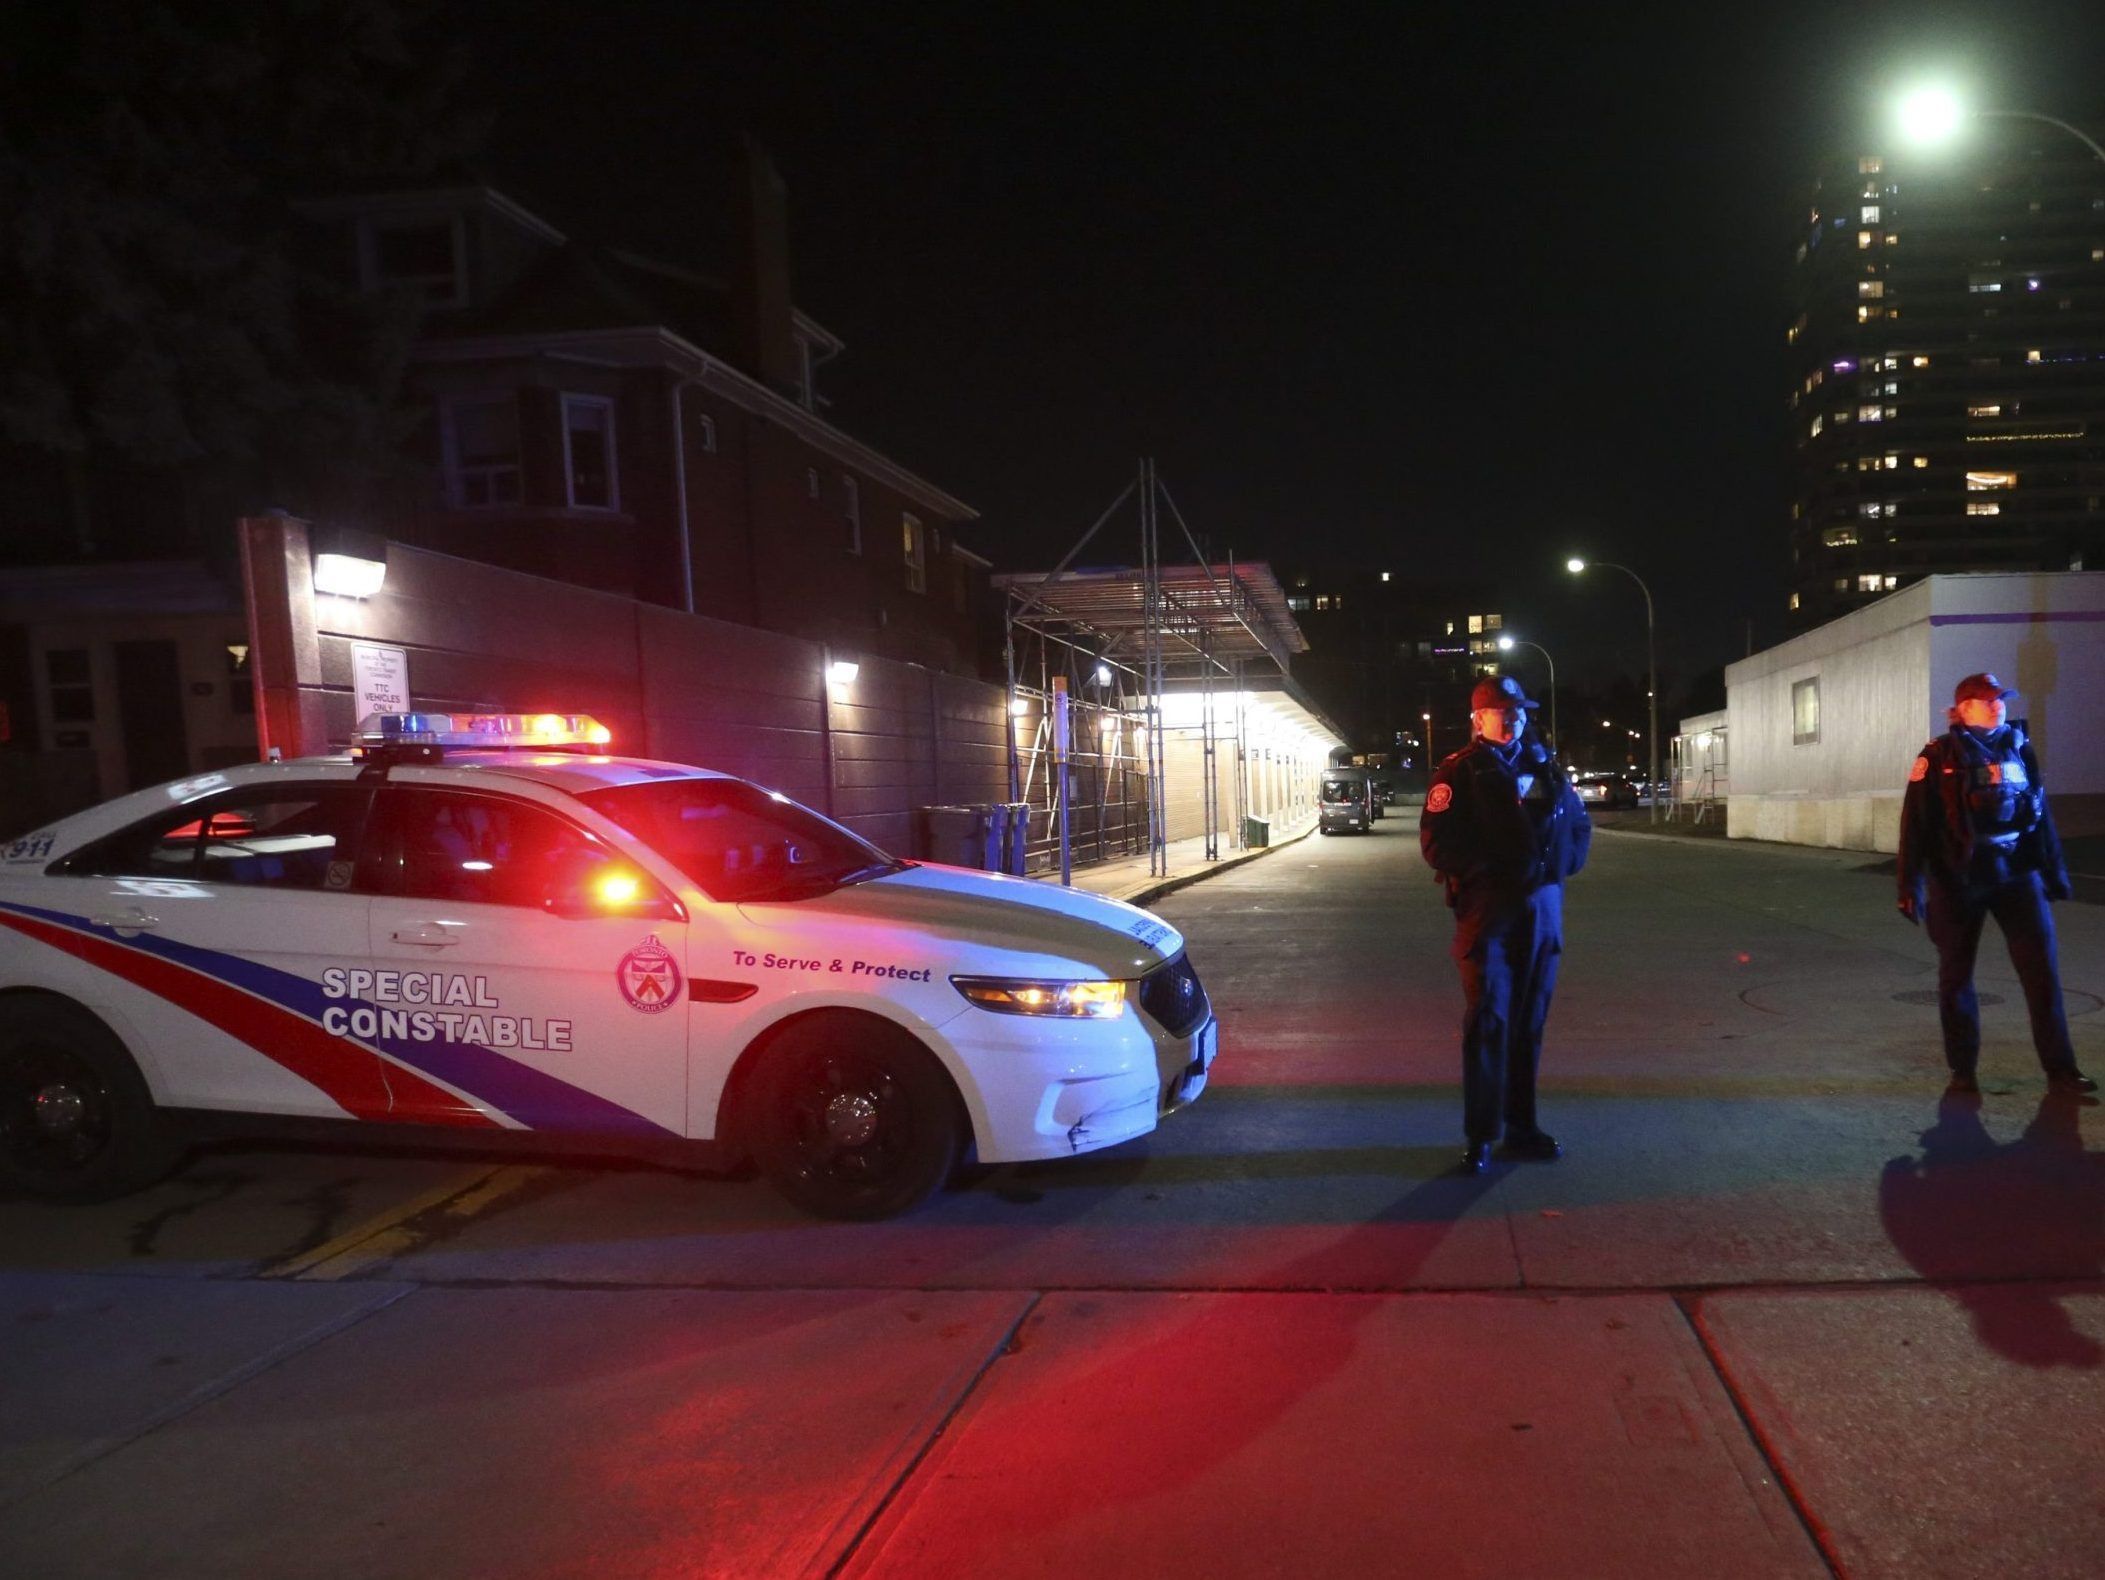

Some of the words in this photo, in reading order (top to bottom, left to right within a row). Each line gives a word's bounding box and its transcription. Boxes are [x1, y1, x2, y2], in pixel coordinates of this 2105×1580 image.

[364, 693, 400, 703] VEHICLES
[374, 683, 389, 692] TTC
[373, 703, 392, 712] ONLY
[733, 951, 756, 967] To
[763, 953, 821, 973] Serve
[829, 959, 843, 973] &
[852, 960, 931, 983] Protect
[322, 967, 498, 1009] SPECIAL
[322, 1006, 573, 1052] CONSTABLE
